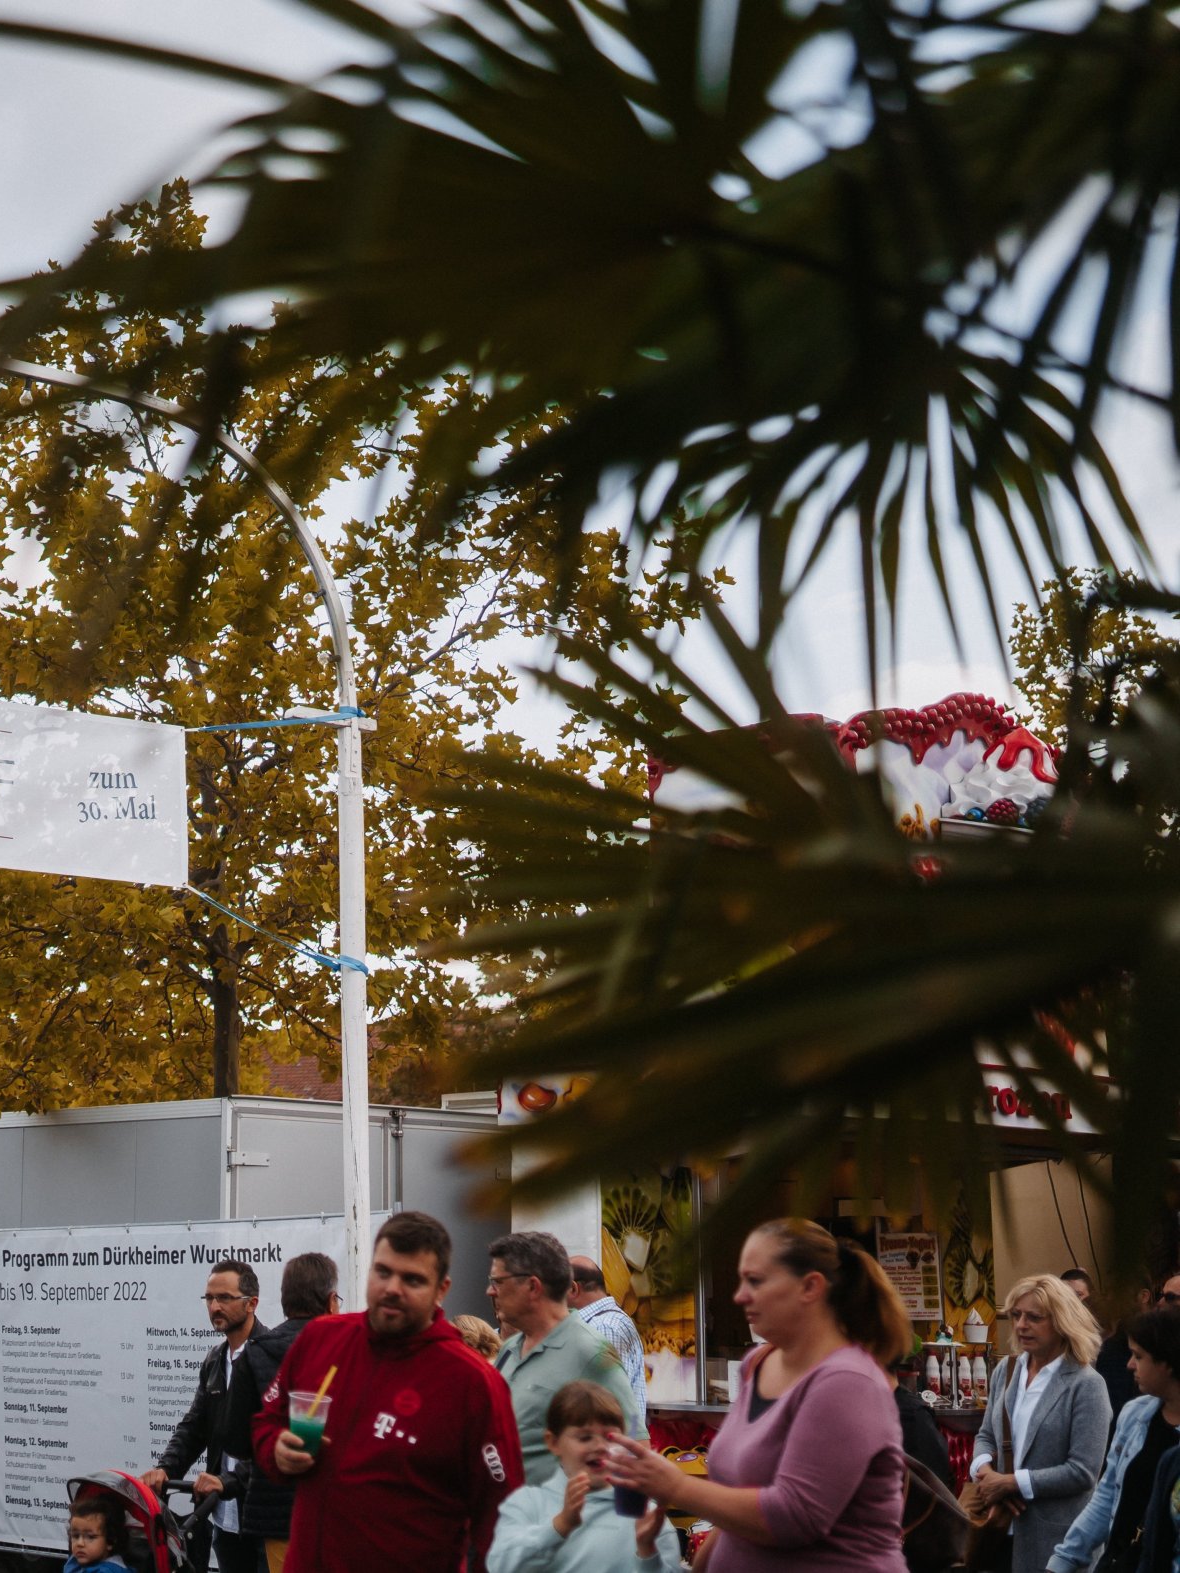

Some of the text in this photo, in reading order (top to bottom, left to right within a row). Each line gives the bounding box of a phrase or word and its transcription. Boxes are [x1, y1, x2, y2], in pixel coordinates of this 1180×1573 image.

[89, 771, 138, 789] zum
[77, 801, 108, 823] 30.
[2, 1249, 69, 1271] Programm
[72, 1252, 99, 1267] zum
[103, 1246, 186, 1267] Dürkheimer
[190, 1242, 282, 1264] Wurstmarkt
[0, 1283, 16, 1301] bis
[19, 1283, 37, 1301] 19.
[40, 1282, 109, 1305] September
[113, 1281, 147, 1301] 2022
[1, 1325, 61, 1336] Freitag, 9. September
[146, 1327, 179, 1339] Mittwoch,
[180, 1328, 189, 1337] 14.
[147, 1358, 172, 1370] Freitag,
[174, 1359, 183, 1368] 16.
[4, 1402, 28, 1414] Sonntag,
[37, 1404, 68, 1414] September
[148, 1397, 194, 1407] Schlagernachmitta
[4, 1435, 68, 1449] Montag, 12. September
[5, 1494, 33, 1508] Dienstag,
[42, 1499, 69, 1510] Septemb
